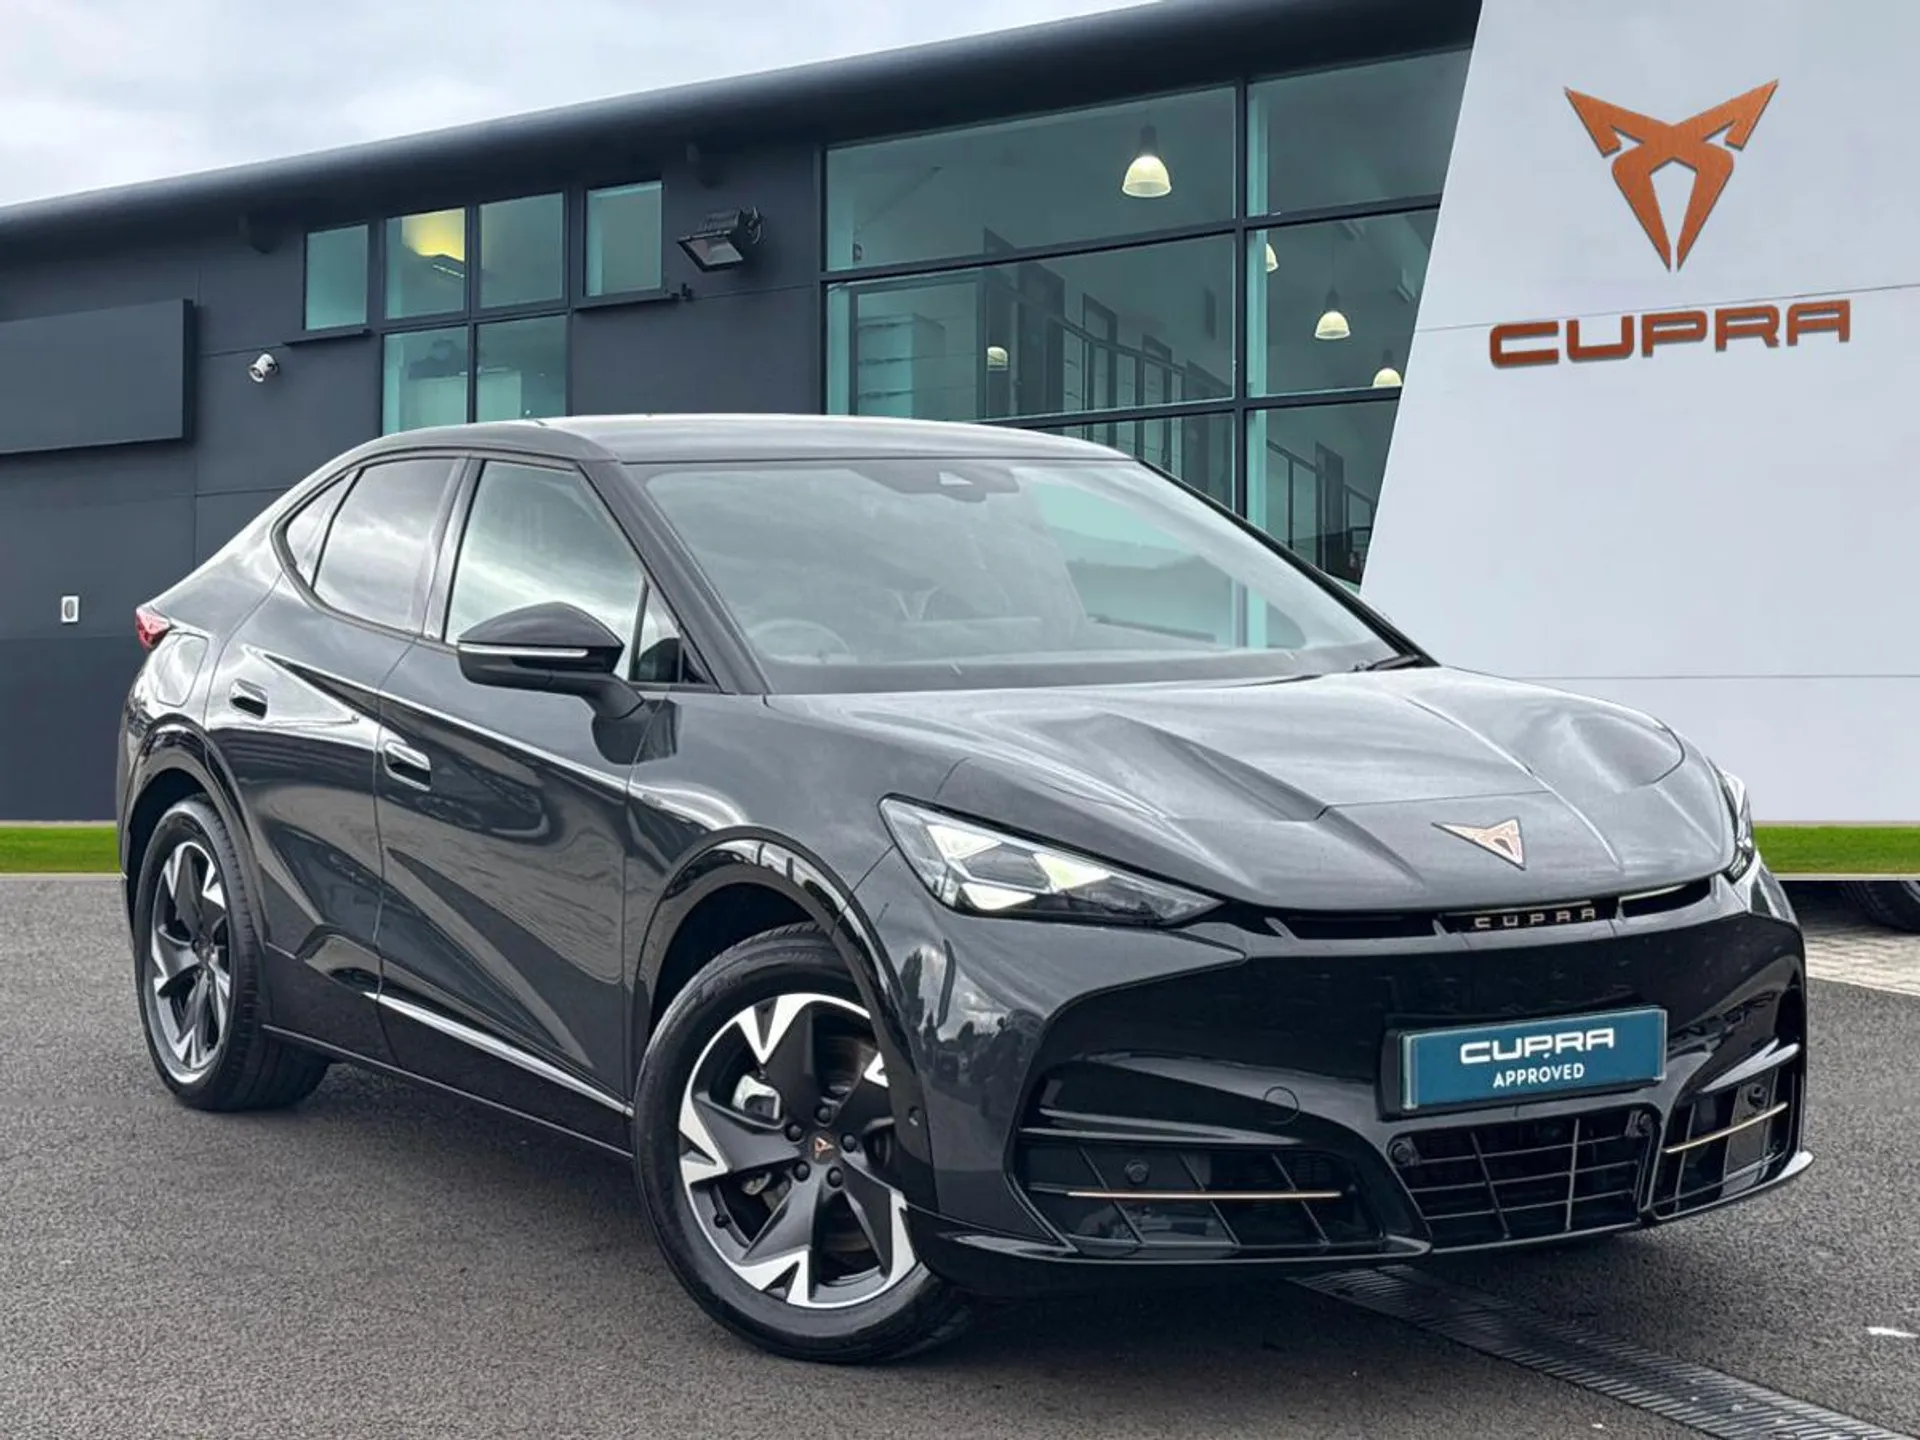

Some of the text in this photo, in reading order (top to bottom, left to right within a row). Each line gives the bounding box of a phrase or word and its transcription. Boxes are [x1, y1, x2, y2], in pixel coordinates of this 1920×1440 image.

[1489, 299, 1850, 368] CUPRA
[1474, 908, 1595, 928] CUPRA
[1460, 1028, 1614, 1064] CUPRA
[1493, 1063, 1585, 1088] APPROVED
